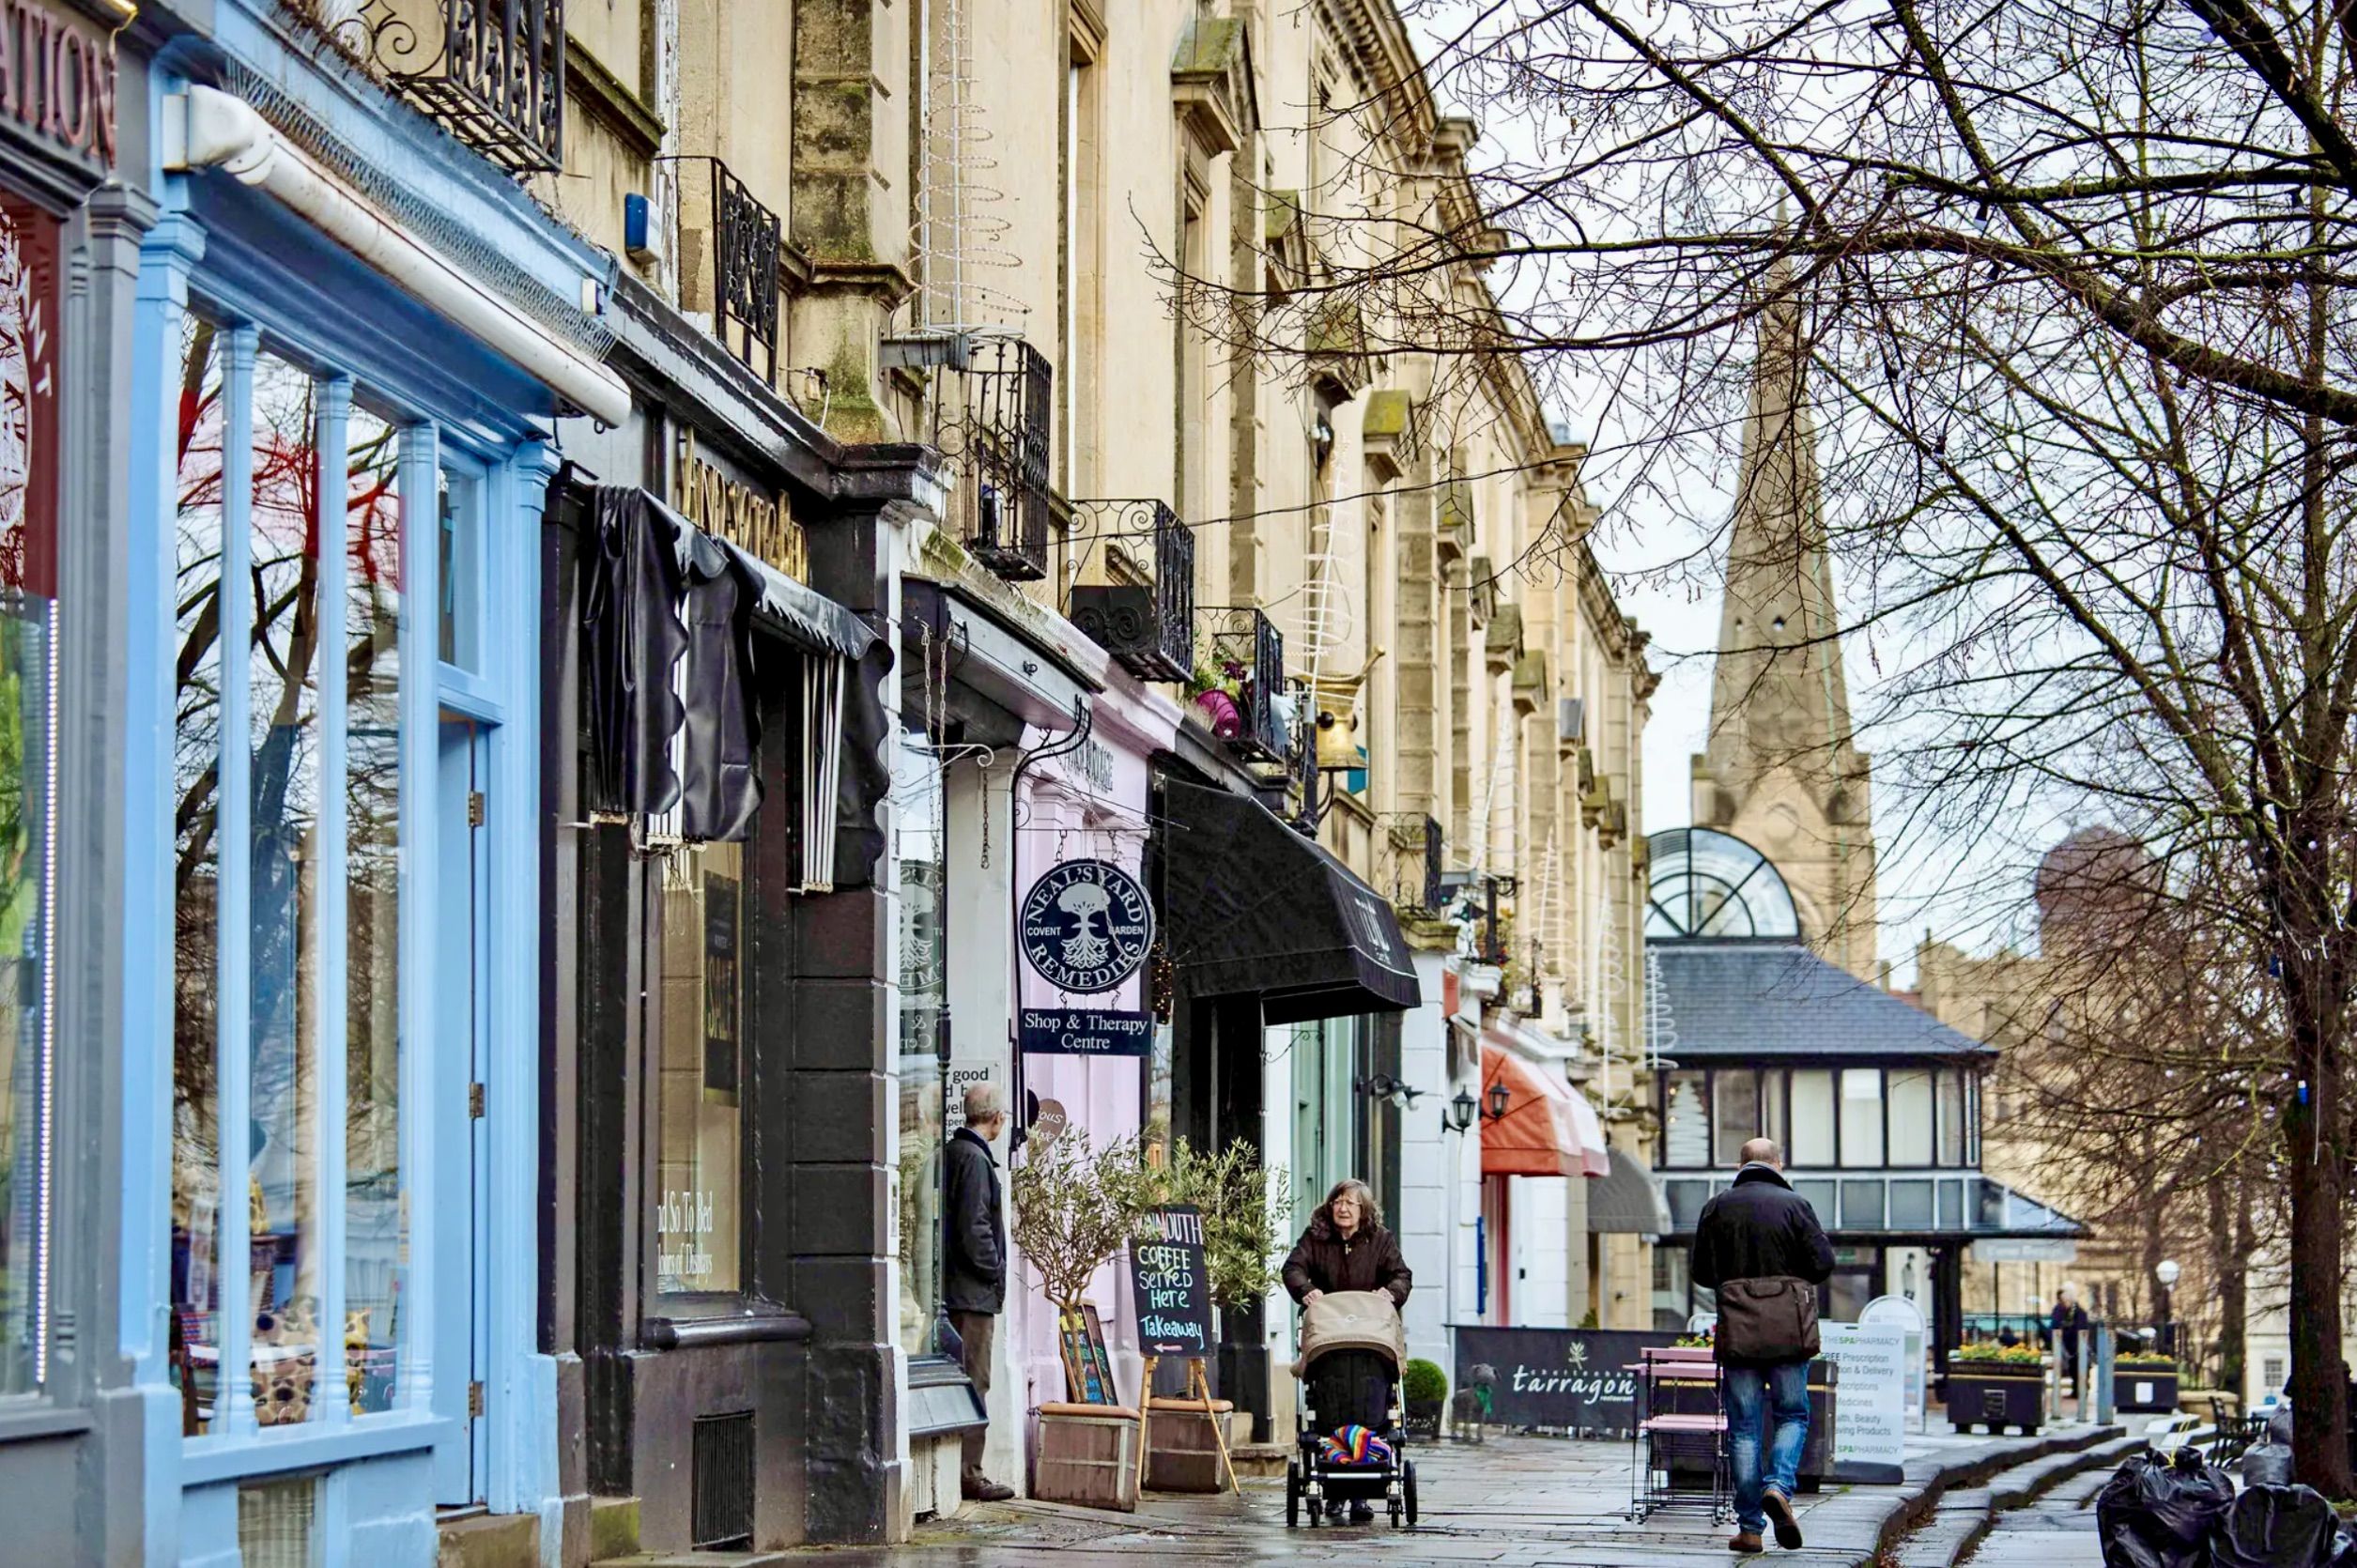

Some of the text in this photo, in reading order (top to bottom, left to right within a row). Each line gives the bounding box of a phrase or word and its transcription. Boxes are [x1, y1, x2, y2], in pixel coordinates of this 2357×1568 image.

[1027, 867, 1144, 924] NEAL'S YARD
[1027, 926, 1061, 936] COVENT
[1108, 926, 1144, 935] GARDEN
[1031, 941, 1140, 986] REMEDIES
[1024, 1013, 1148, 1035] Shop & Therapy
[1061, 1034, 1110, 1050] Centre
[953, 1068, 989, 1084] good
[683, 1191, 695, 1232] To
[697, 1191, 713, 1232] Bed
[1137, 1245, 1191, 1271] COFFEE
[1150, 1289, 1190, 1310] Here
[1140, 1314, 1205, 1350] Takeaway
[1842, 1353, 1889, 1363] Prescription
[1862, 1365, 1894, 1376] Delivery
[1513, 1364, 1634, 1405] tarragon
[1855, 1413, 1881, 1424] Beauty
[1856, 1425, 1891, 1436] Products
